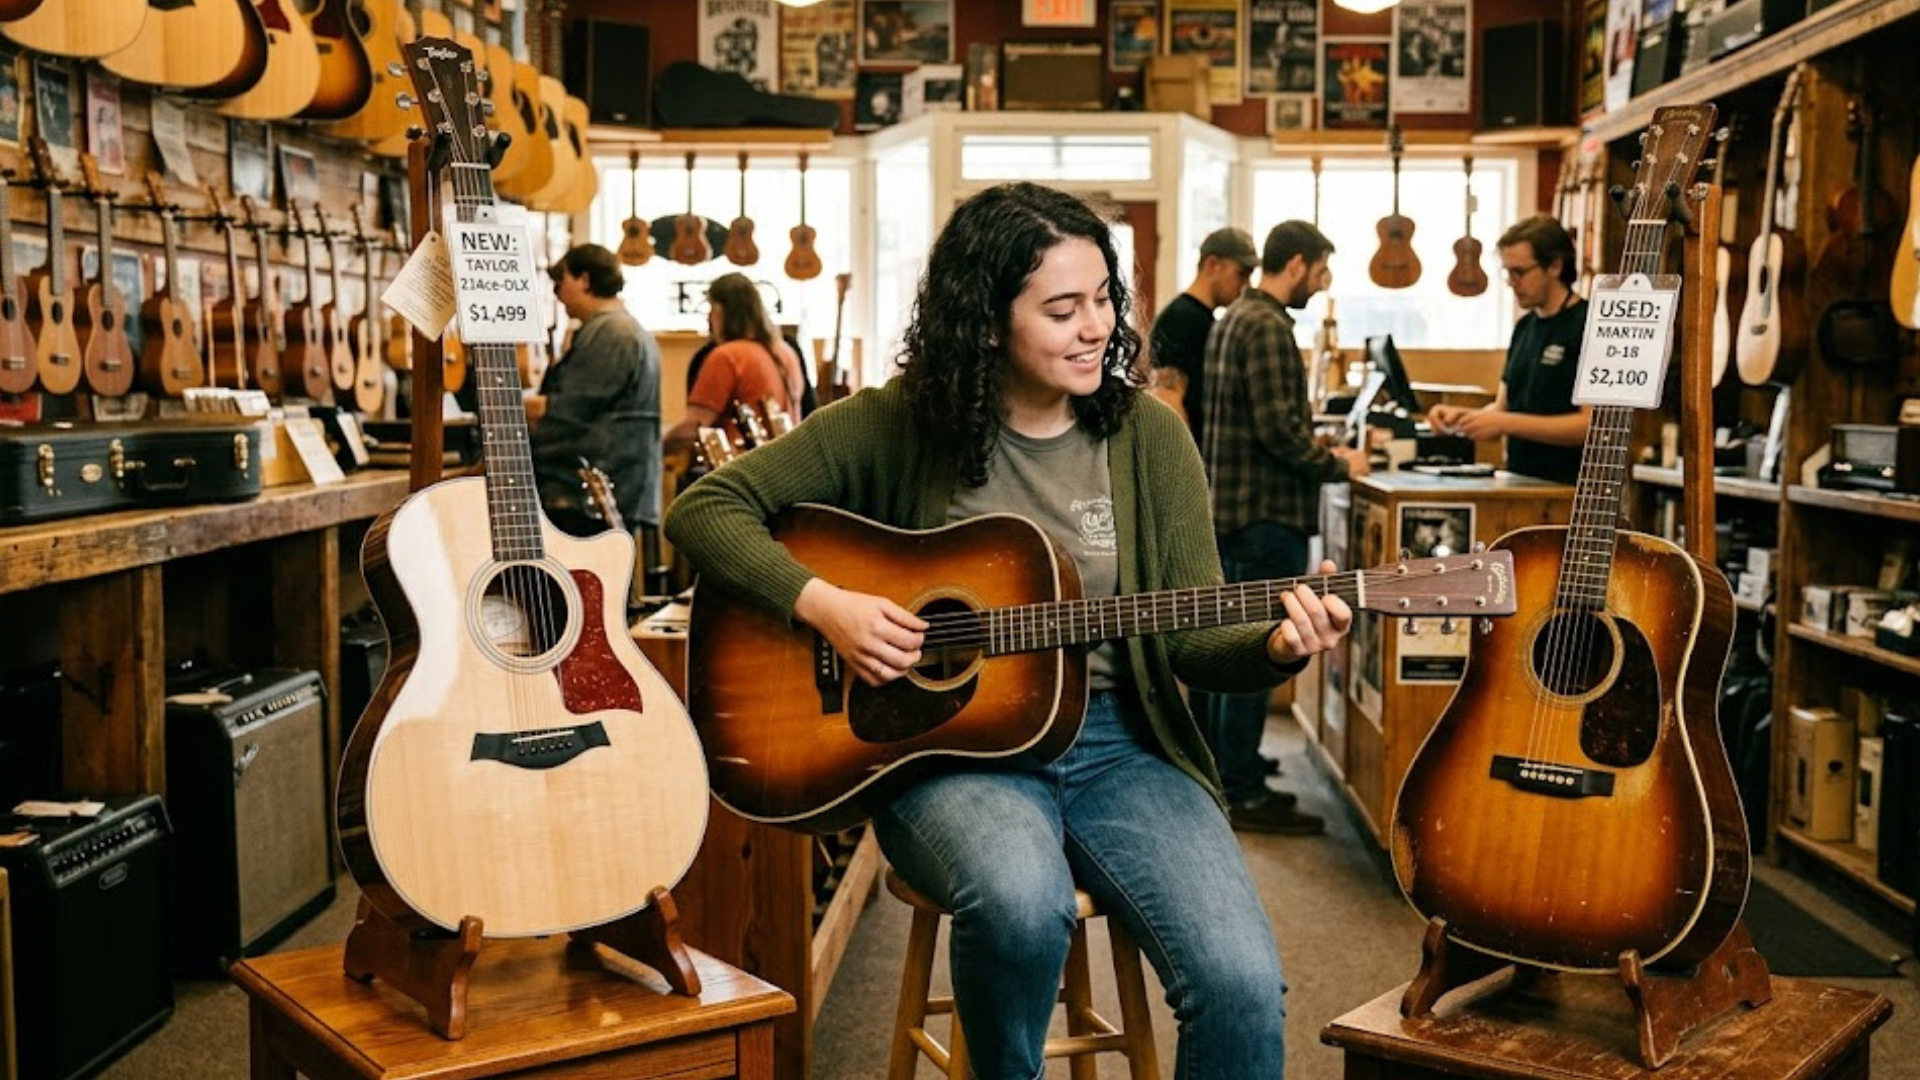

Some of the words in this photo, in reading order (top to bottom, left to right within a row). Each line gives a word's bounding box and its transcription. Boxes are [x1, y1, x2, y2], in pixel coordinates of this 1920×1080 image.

[461, 232, 518, 251] NEW:
[465, 259, 519, 273] TAYLOR
[469, 303, 526, 323] $1,499
[1600, 300, 1660, 319] USED:
[1596, 326, 1655, 339] MARTIN
[1589, 367, 1648, 387] $2,100
